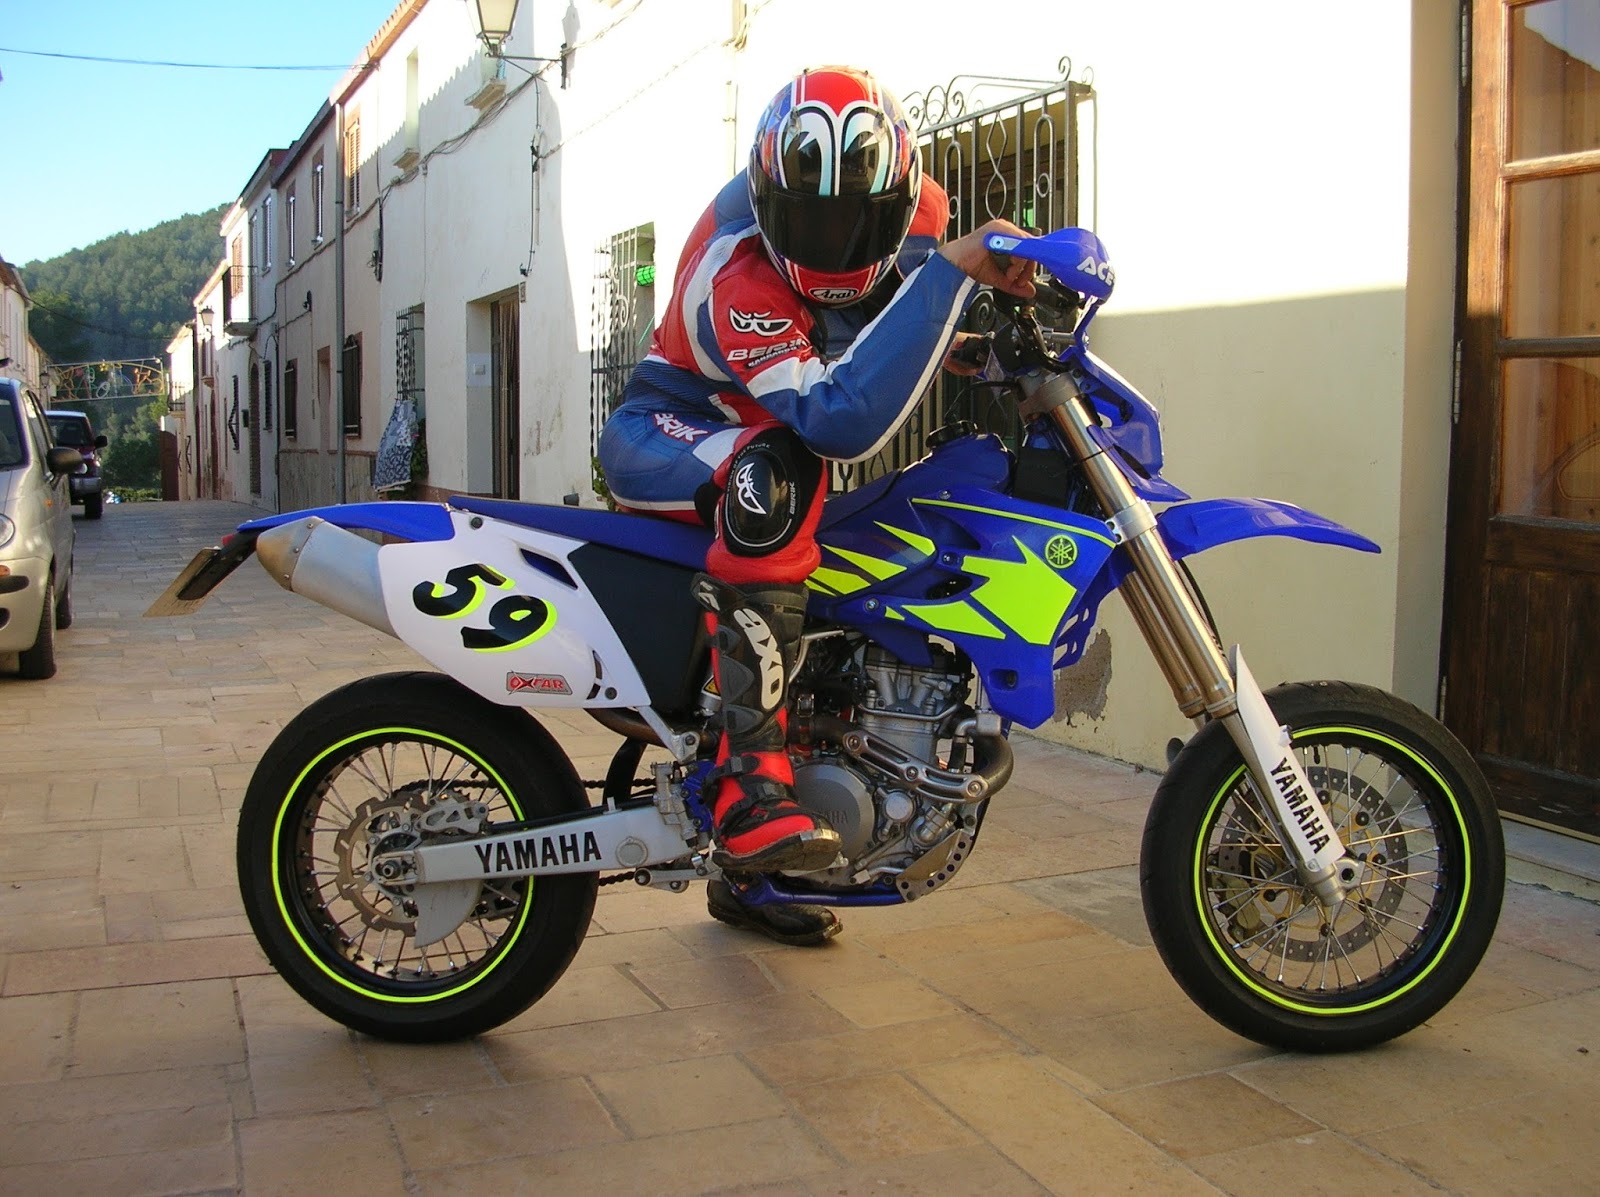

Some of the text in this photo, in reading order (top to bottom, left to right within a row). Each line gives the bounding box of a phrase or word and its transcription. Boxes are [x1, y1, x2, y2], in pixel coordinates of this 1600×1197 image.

[813, 289, 855, 301] Arai
[412, 562, 556, 652] 59
[1270, 757, 1331, 854] YAMAHA
[474, 831, 602, 874] YAMAHA
